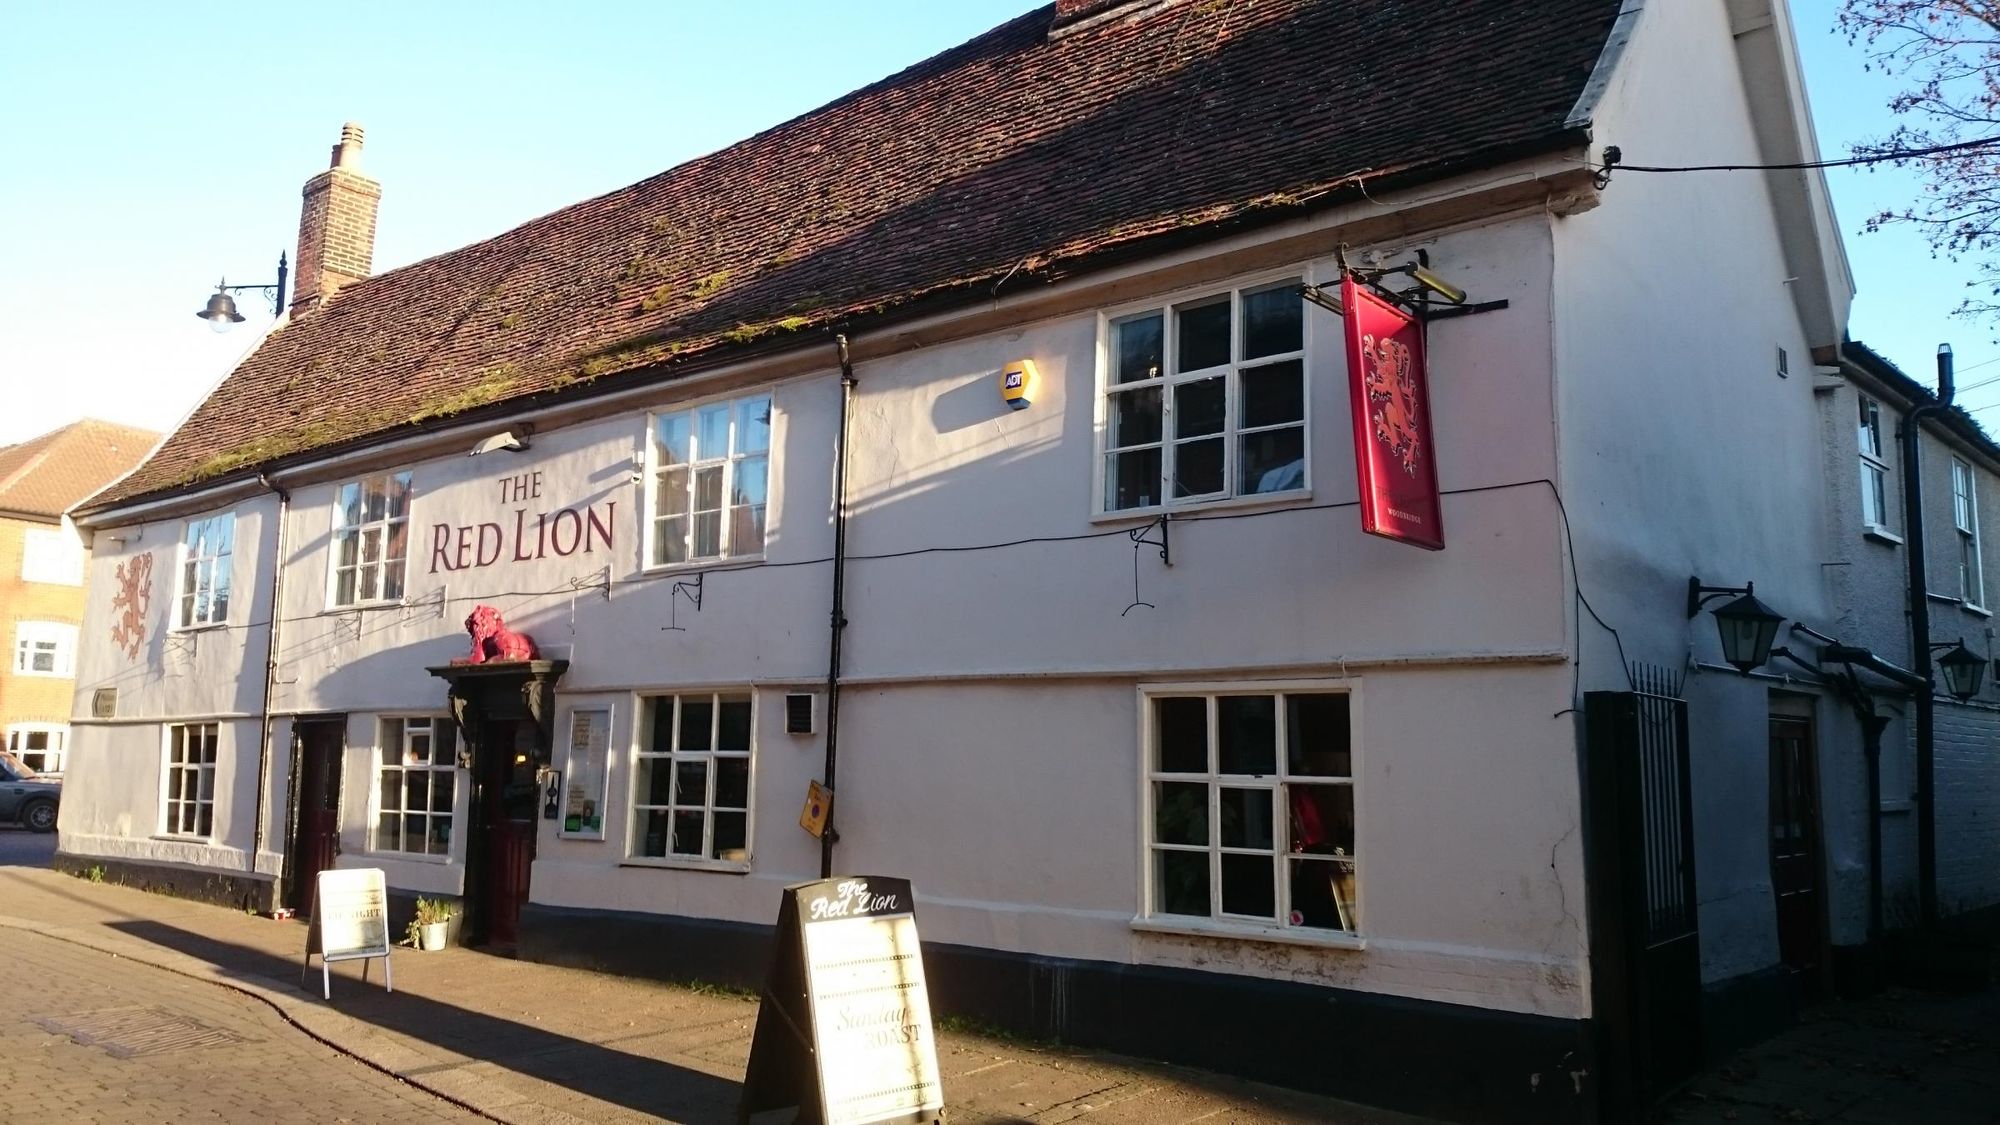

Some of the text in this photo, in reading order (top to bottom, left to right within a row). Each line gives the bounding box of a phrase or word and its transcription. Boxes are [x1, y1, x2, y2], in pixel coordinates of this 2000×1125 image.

[1006, 373, 1022, 387] ADT
[499, 471, 542, 504] THE
[428, 501, 616, 575] RED LION
[837, 880, 868, 898] The
[811, 891, 899, 920] Red Lion
[837, 1001, 907, 1031] Sunday
